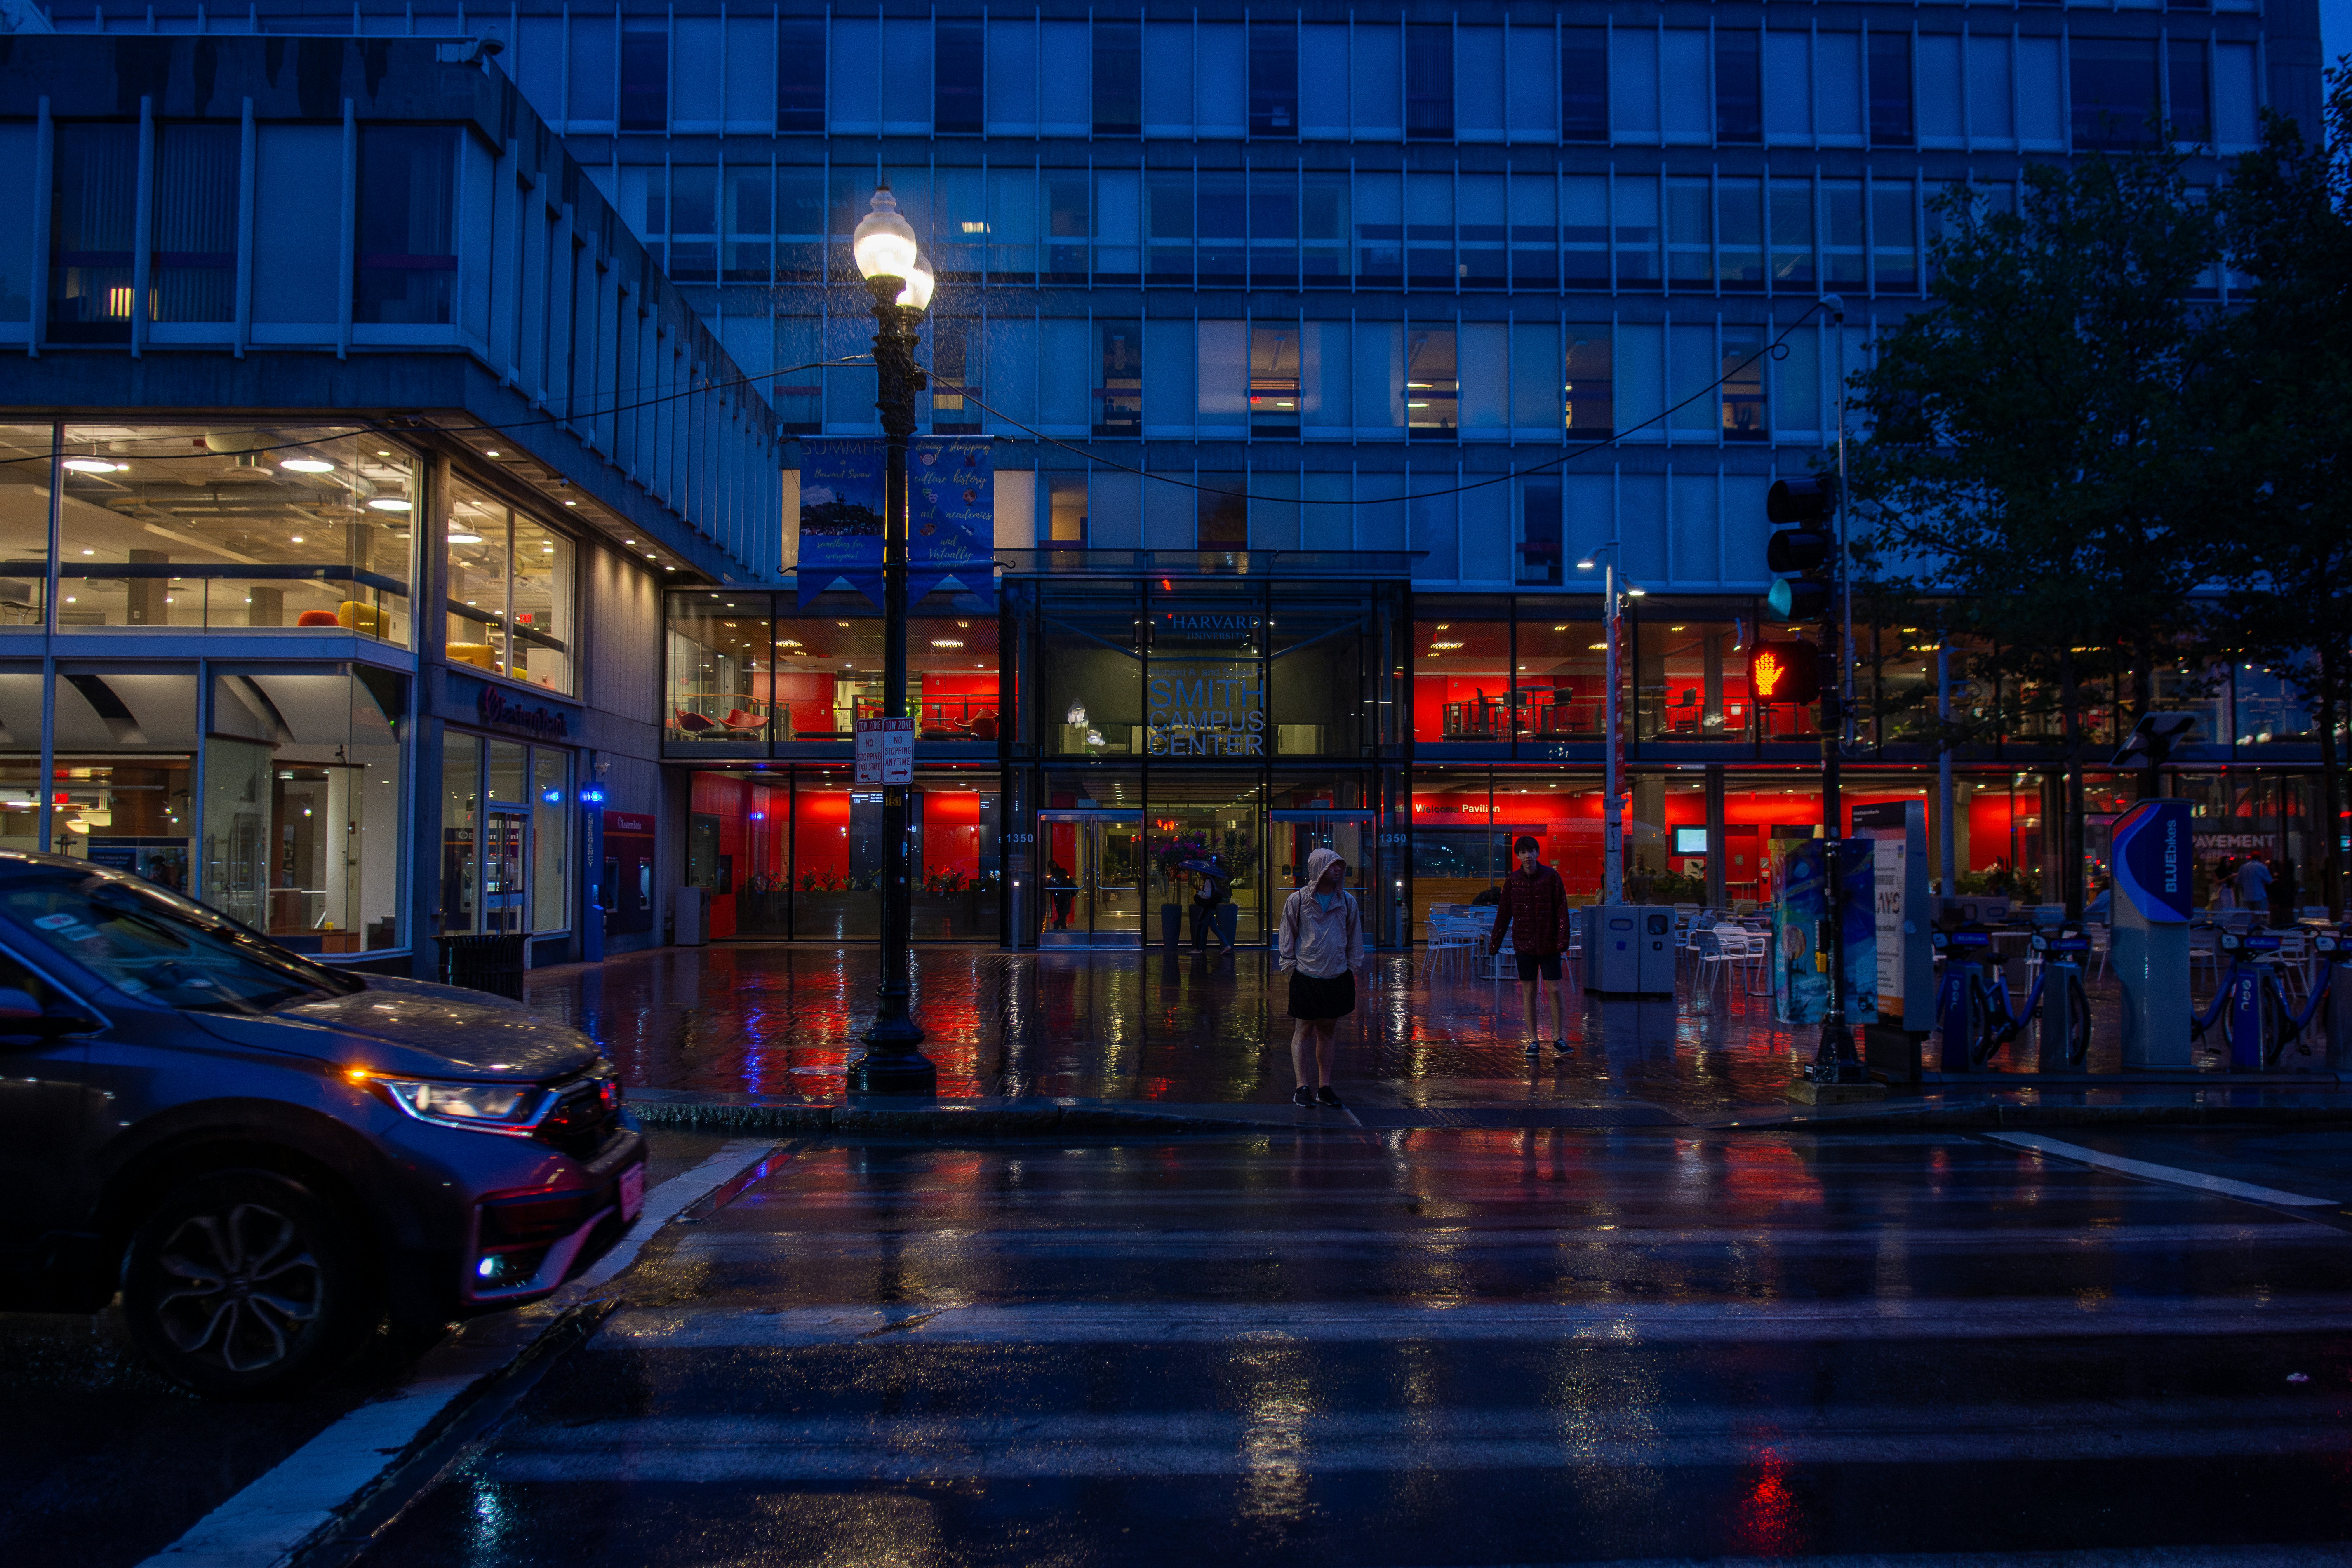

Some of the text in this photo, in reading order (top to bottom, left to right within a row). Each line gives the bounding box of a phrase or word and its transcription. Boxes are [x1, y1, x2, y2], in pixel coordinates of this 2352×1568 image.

[802, 439, 884, 454] SUMMER
[916, 436, 990, 460] dining shopping
[814, 468, 871, 478] Harvard Square
[914, 469, 987, 489] culture history
[921, 506, 993, 521] art academics
[816, 537, 863, 551] something for
[940, 535, 958, 546] and
[929, 546, 973, 563] Virtually
[1173, 616, 1261, 629] HARVARD
[1149, 668, 1186, 676] Richard
[1188, 668, 1198, 676] A.
[1201, 668, 1219, 676] and
[1150, 679, 1264, 708] SMITH
[859, 721, 881, 731] TOW ZONE
[886, 720, 912, 730] TOW ZONE
[1149, 710, 1264, 732] CAMPUS
[866, 739, 873, 747] NO
[1149, 733, 1264, 756] CENTER
[858, 752, 881, 761] STOPPING
[885, 747, 911, 755] STOPPING
[885, 758, 910, 766] ANYTIME
[1416, 804, 1500, 813] Welcome Pavilin
[1006, 834, 1033, 842] 1350
[1380, 833, 1406, 843] 1350
[2165, 819, 2177, 893] BLUEbikes
